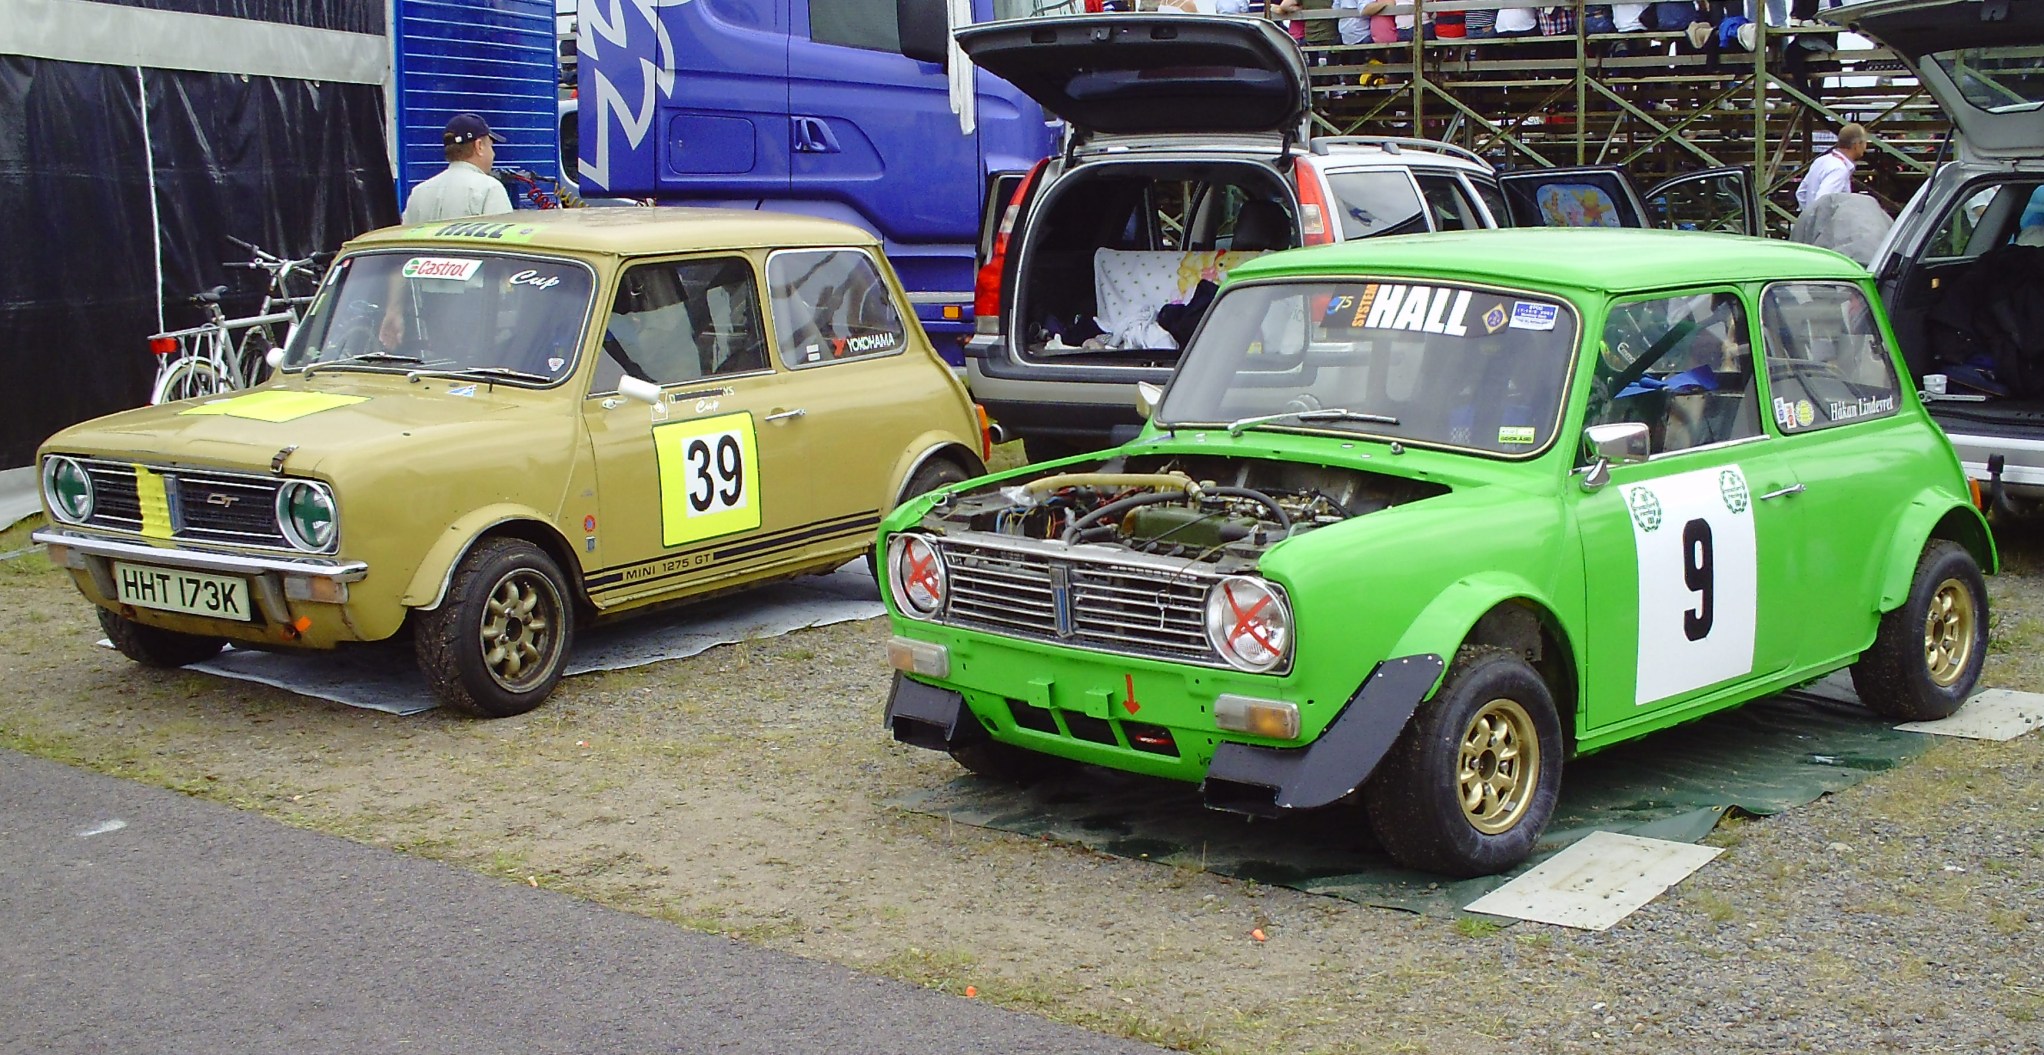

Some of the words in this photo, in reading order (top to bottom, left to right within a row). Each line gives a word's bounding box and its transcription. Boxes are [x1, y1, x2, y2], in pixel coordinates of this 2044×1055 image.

[434, 222, 515, 239] HALL
[417, 260, 470, 277] Castrol
[509, 269, 560, 291] Cup
[1364, 283, 1473, 337] HALL
[846, 332, 896, 353] YOKOHAMA
[695, 400, 720, 414] Cup
[1830, 400, 1858, 421] Håkan
[687, 434, 743, 512] 39
[206, 492, 240, 508] GT
[626, 566, 656, 581] MINI
[662, 558, 689, 572] 1275
[694, 553, 711, 565] GT
[1683, 517, 1714, 642] 9
[122, 568, 171, 604] HHT
[178, 576, 240, 614] 173K
